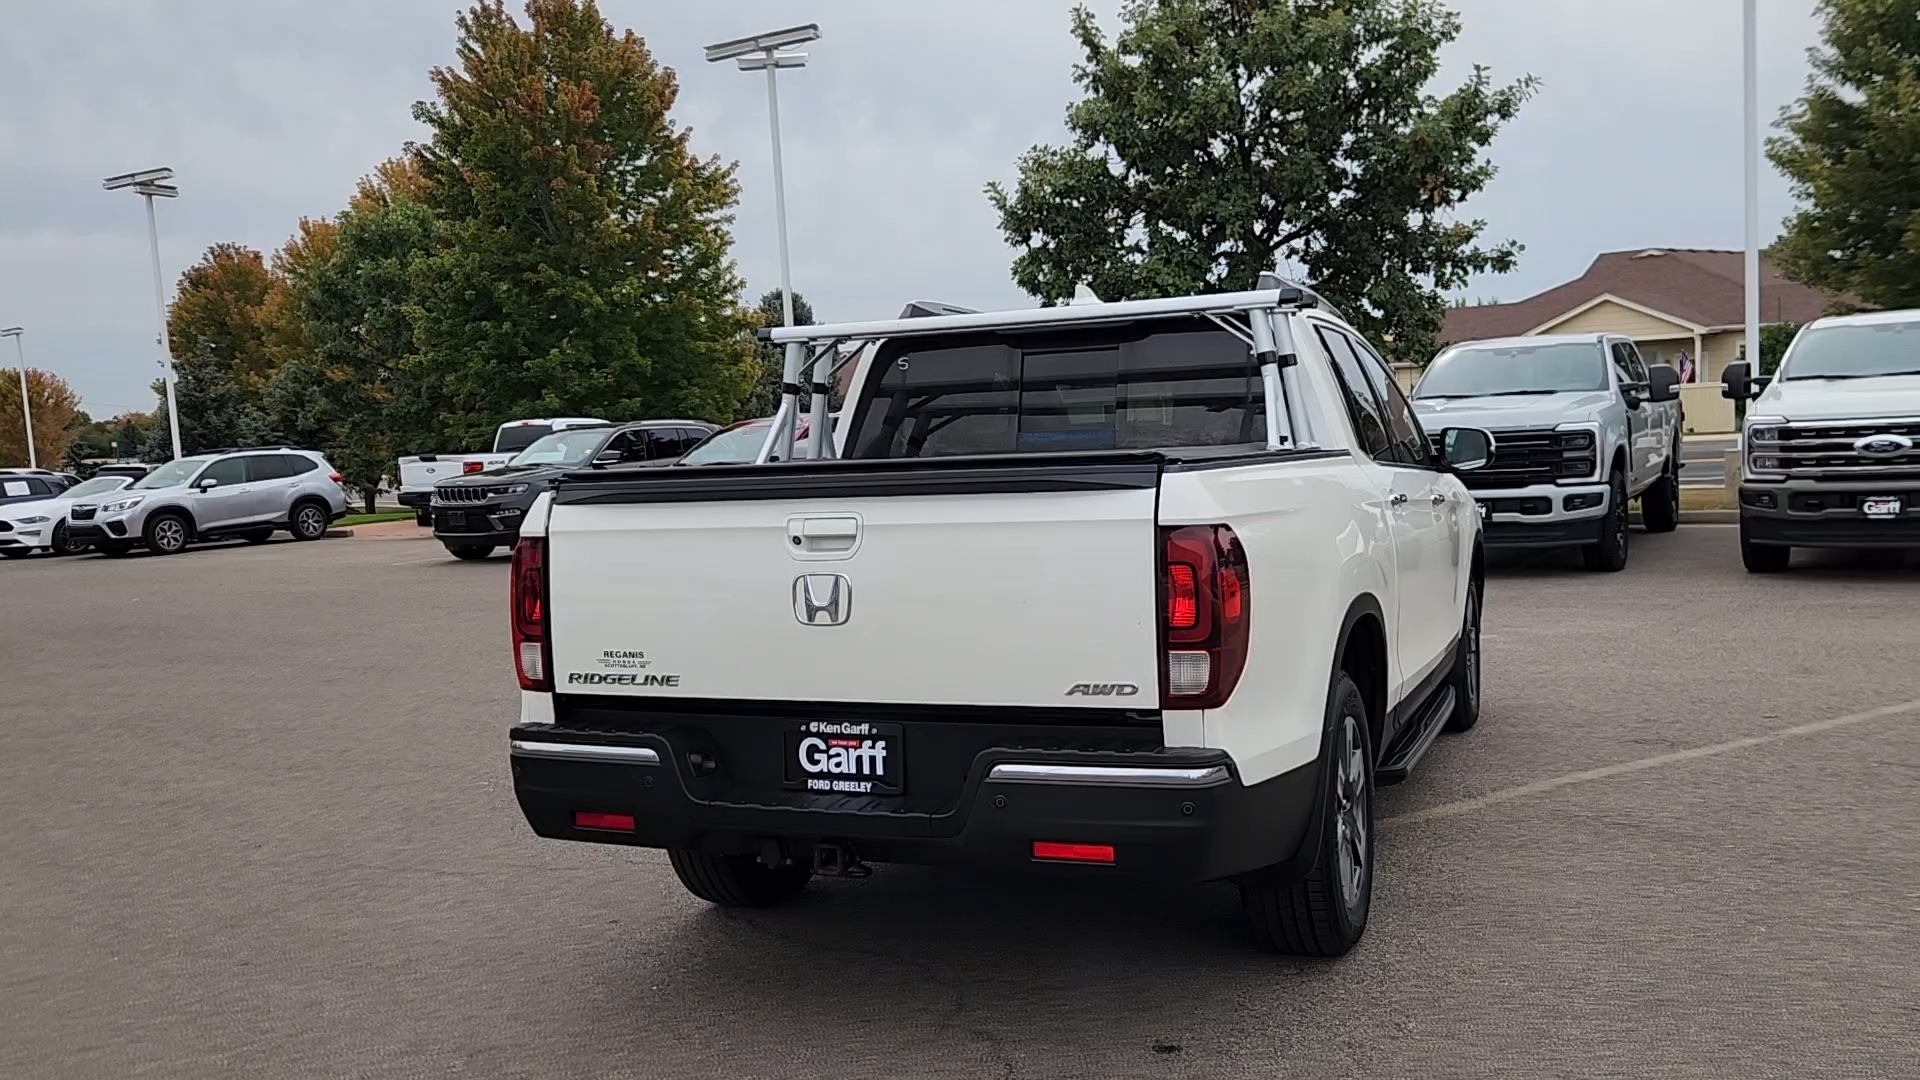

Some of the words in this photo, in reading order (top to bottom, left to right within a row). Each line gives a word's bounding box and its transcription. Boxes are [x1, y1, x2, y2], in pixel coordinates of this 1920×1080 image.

[603, 650, 645, 659] REGANIS
[568, 672, 680, 687] RIDGELINE
[1064, 683, 1139, 696] AWD
[819, 721, 841, 734] Ken
[841, 722, 870, 735] Garff
[798, 736, 887, 776] Garff
[807, 779, 831, 790] FORD
[832, 780, 872, 792] GREELEY
